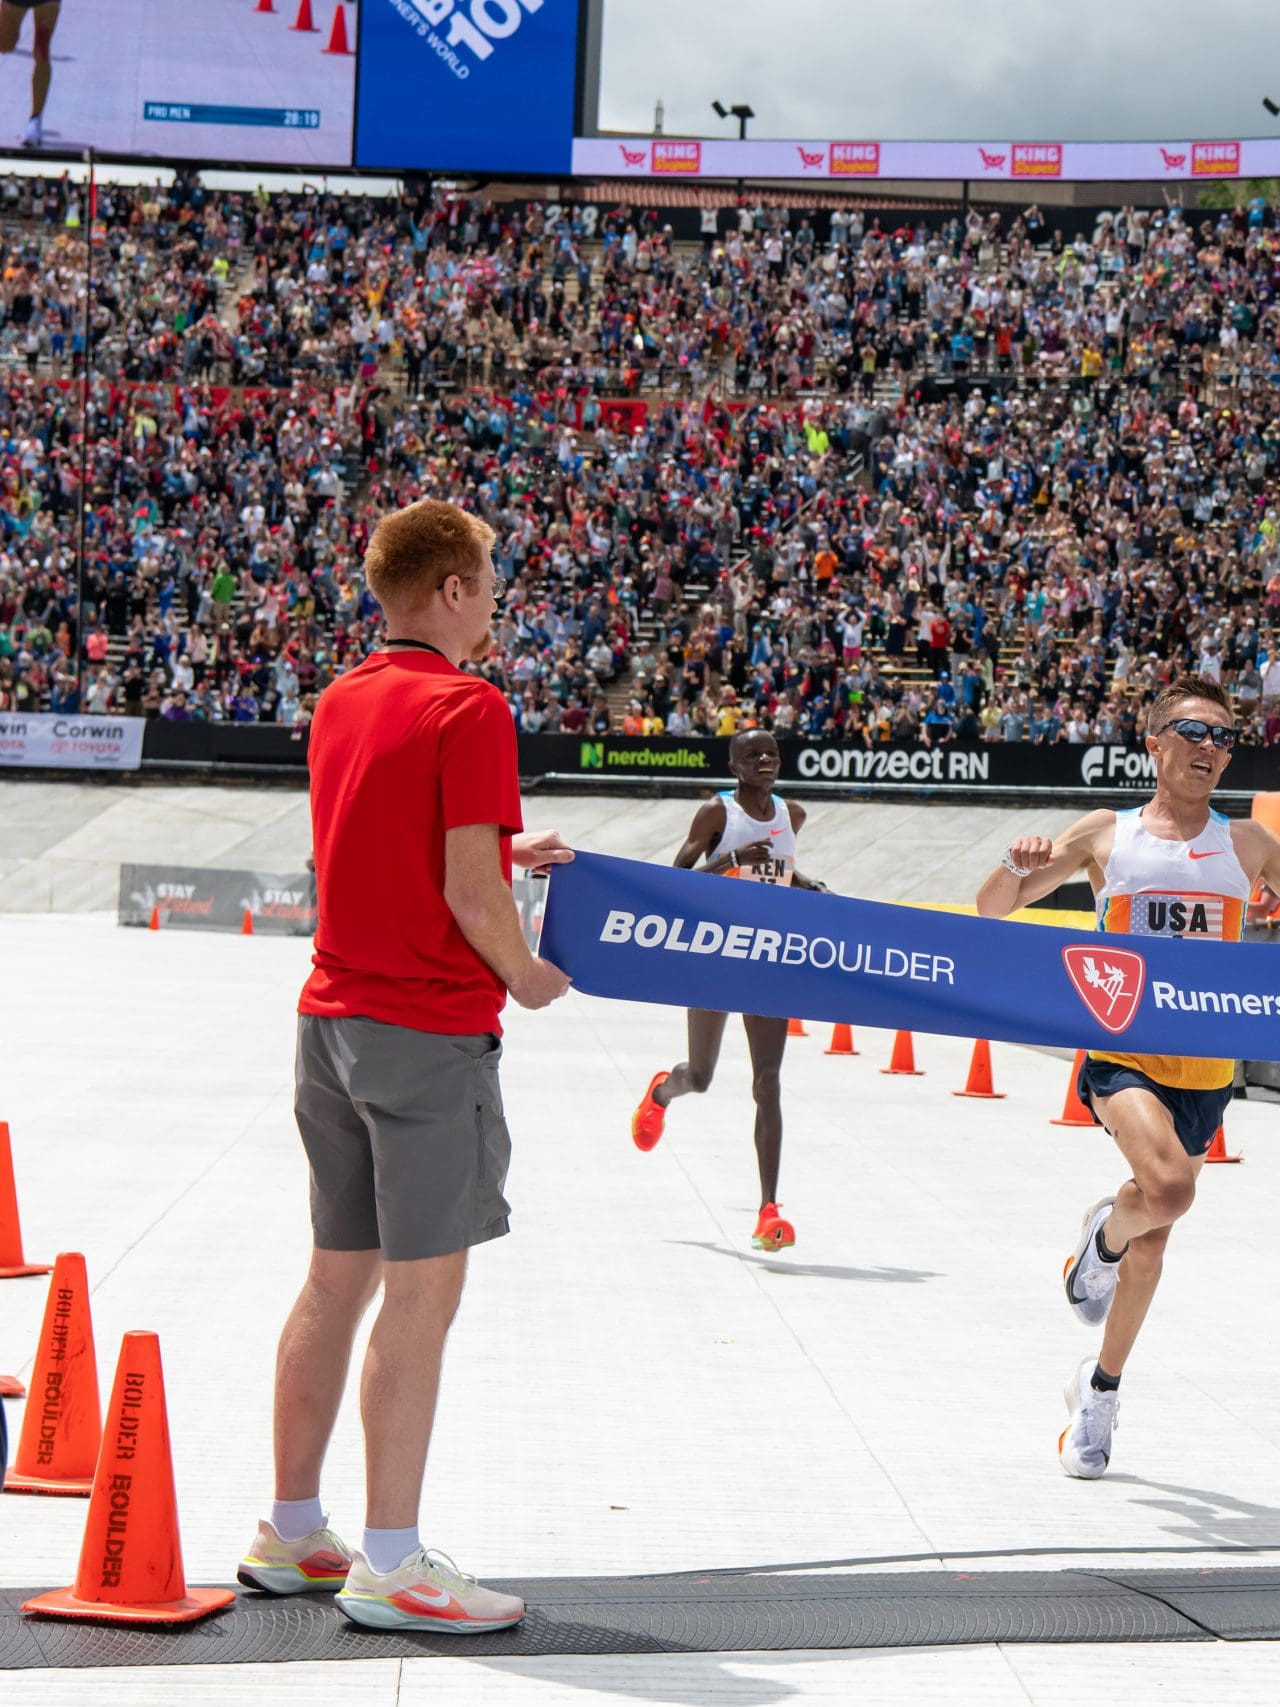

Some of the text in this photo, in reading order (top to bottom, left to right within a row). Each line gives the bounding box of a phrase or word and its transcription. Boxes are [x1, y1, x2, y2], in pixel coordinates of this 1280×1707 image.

[427, 32, 470, 80] WORLD
[147, 105, 191, 119] PRO MEN
[656, 142, 698, 159] KING
[834, 144, 877, 160] KING
[1015, 146, 1059, 162] KING
[1195, 146, 1237, 161] KING
[53, 721, 124, 740] Corwin
[71, 740, 122, 754] TOYOTA
[752, 857, 786, 878] KEN
[156, 883, 197, 899] STAY
[263, 890, 305, 904] STAY
[1147, 901, 1209, 932] USA
[599, 909, 956, 985] BOLDERBOULDER
[36, 1288, 74, 1466] BOLDER BOULDER
[100, 1372, 145, 1590] BOLDER BOULDER
